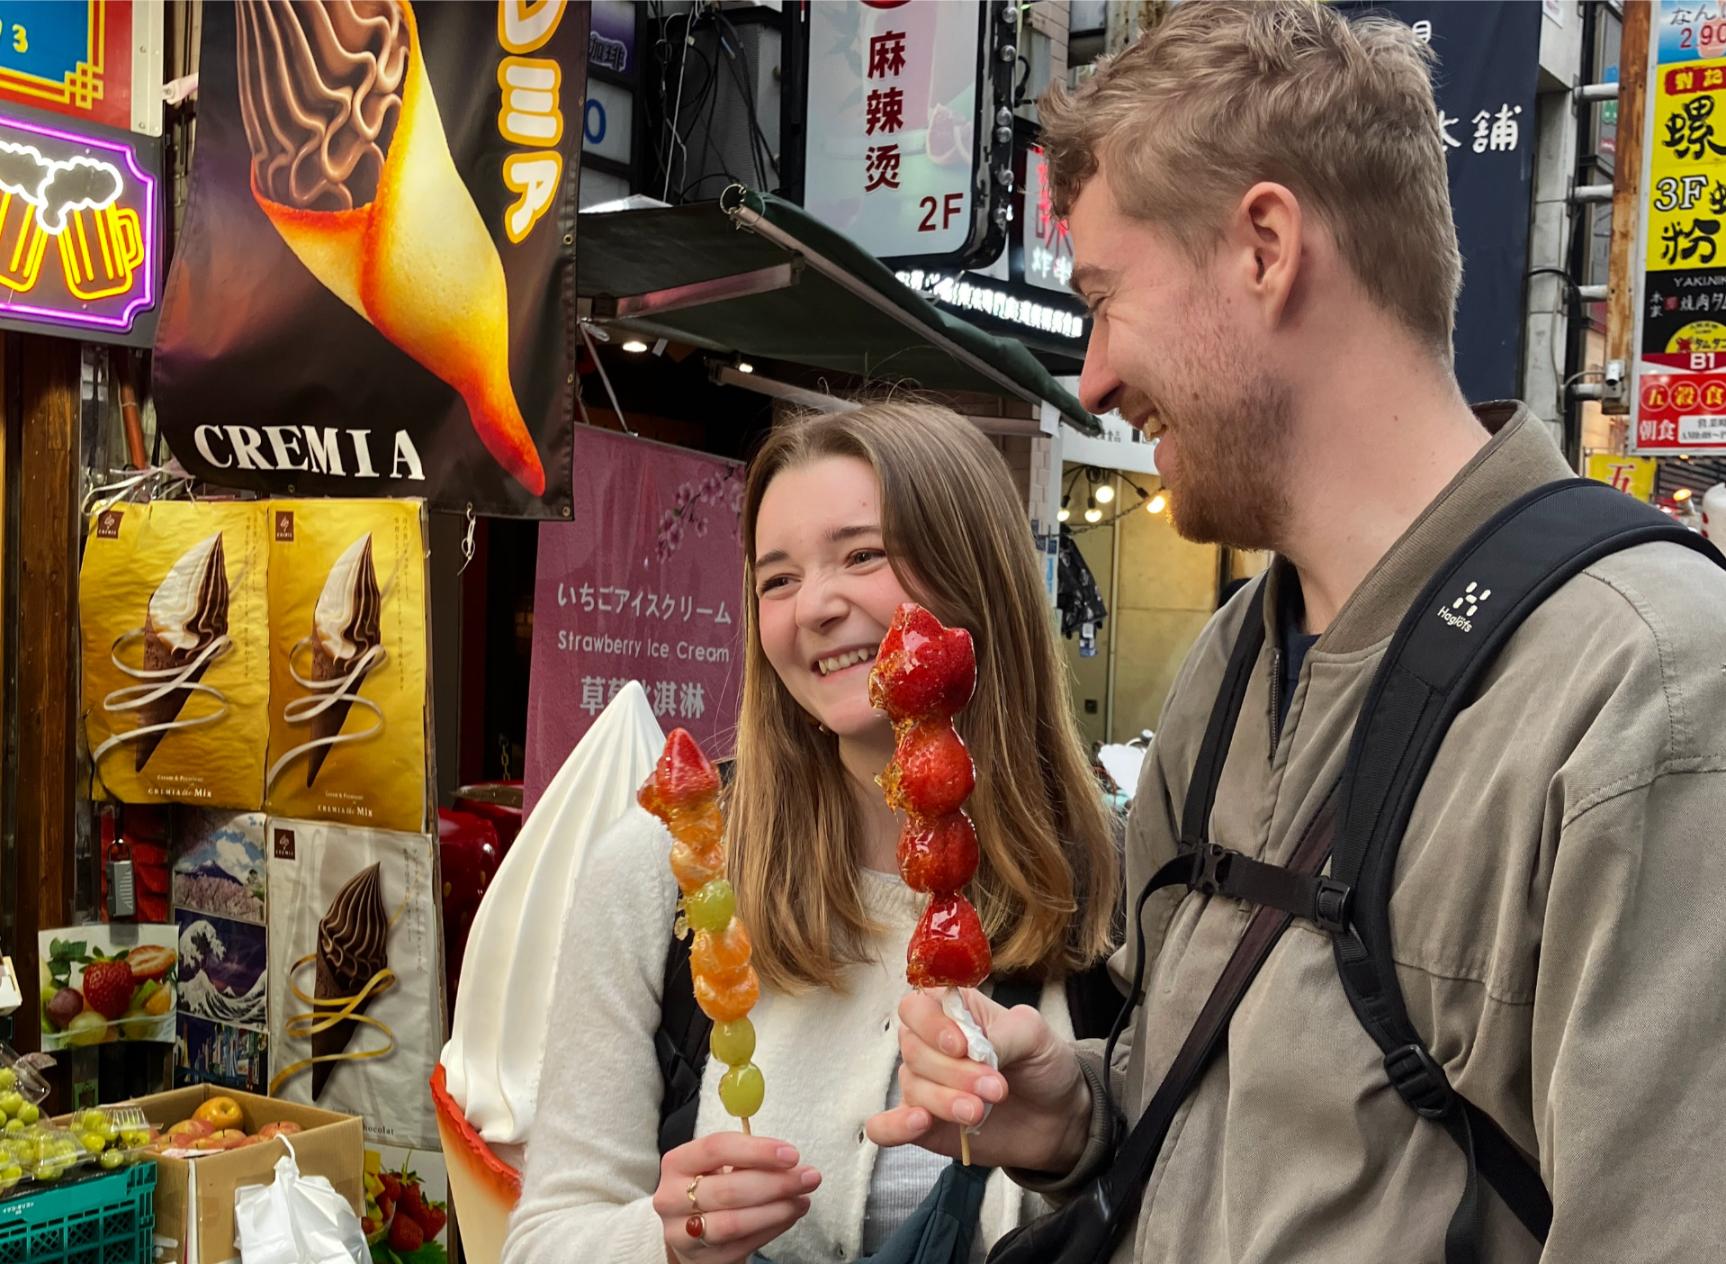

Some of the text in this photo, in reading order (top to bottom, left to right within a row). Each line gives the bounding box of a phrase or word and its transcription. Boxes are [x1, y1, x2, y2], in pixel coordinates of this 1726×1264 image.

[864, 31, 906, 192] 麻辣烫
[918, 193, 964, 232] 2F
[1654, 174, 1708, 212] 3F
[1690, 352, 1715, 370] B1
[194, 424, 426, 480] CREMIA
[557, 582, 732, 624] いちごアイスクリーム
[1437, 605, 1473, 632] Haglöfs
[557, 630, 730, 662] Strawberry Ice Cream
[580, 676, 705, 719] 草淇淋
